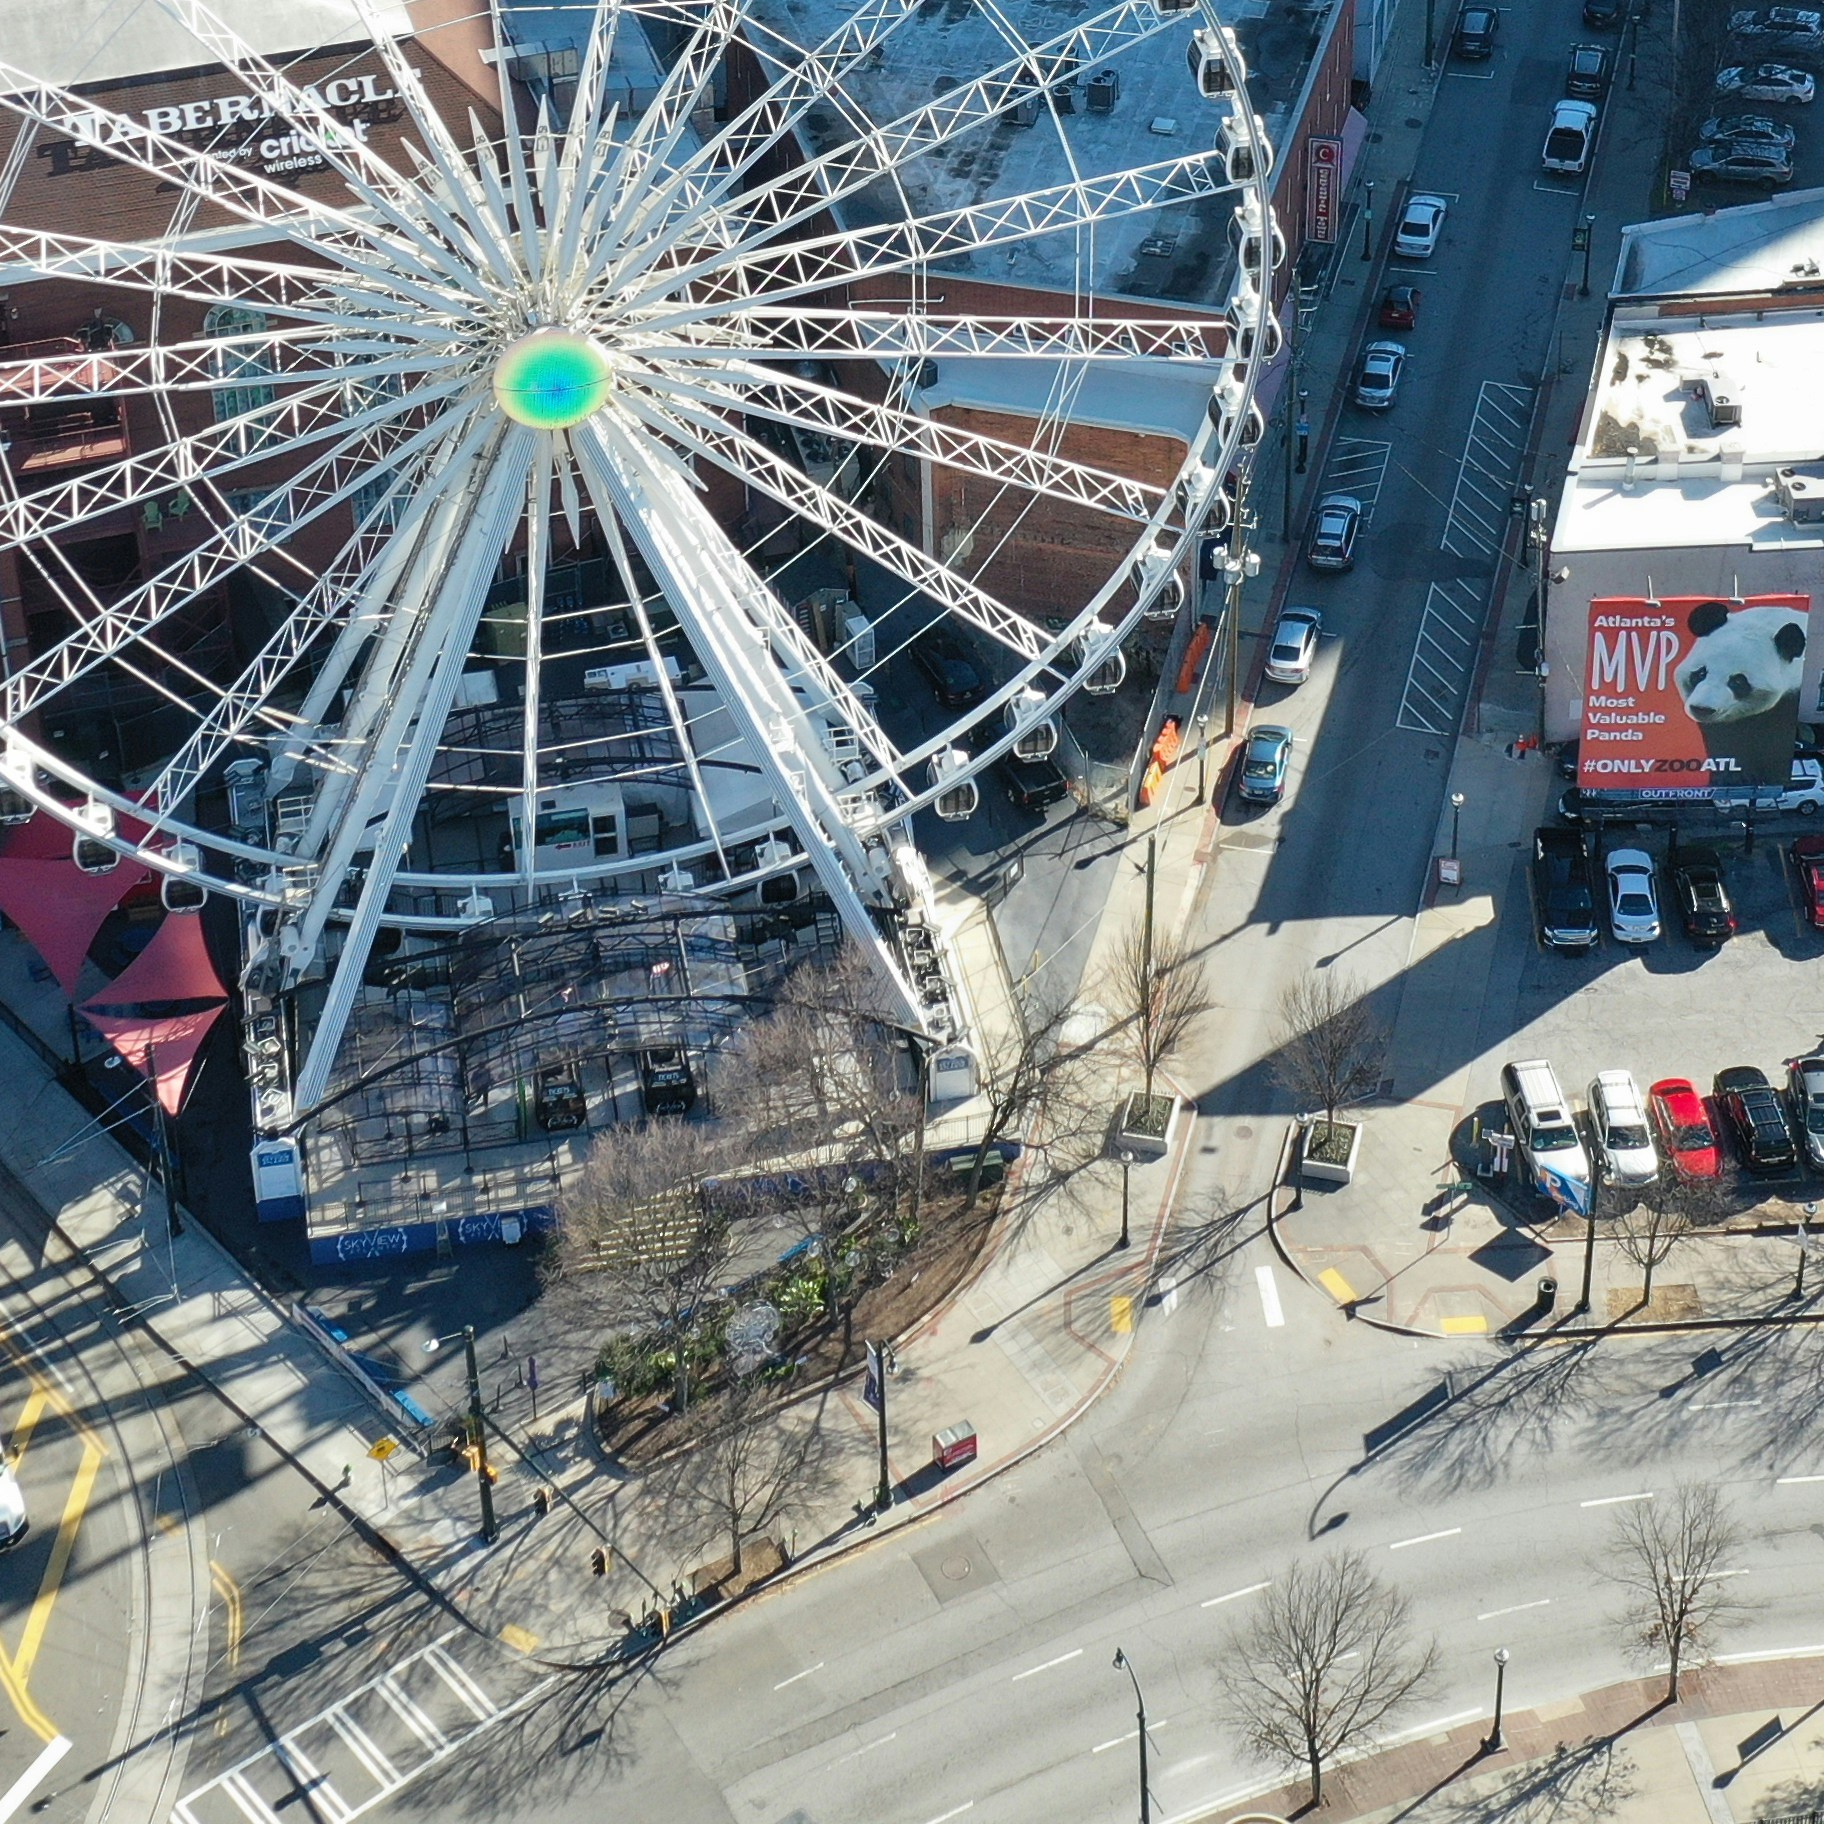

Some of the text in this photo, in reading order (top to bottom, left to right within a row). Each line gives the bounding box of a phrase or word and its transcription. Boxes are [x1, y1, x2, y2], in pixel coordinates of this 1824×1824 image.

[264, 154, 323, 174] wireless
[1594, 614, 1676, 629] Atlanta's
[1591, 630, 1680, 694] MVP
[1588, 695, 1635, 709] Most
[1587, 711, 1666, 725] Valuable
[1586, 728, 1644, 742] Panda
[1582, 757, 1742, 775] #ONLYZOOATL
[1641, 788, 1713, 800] OUTFRONT
